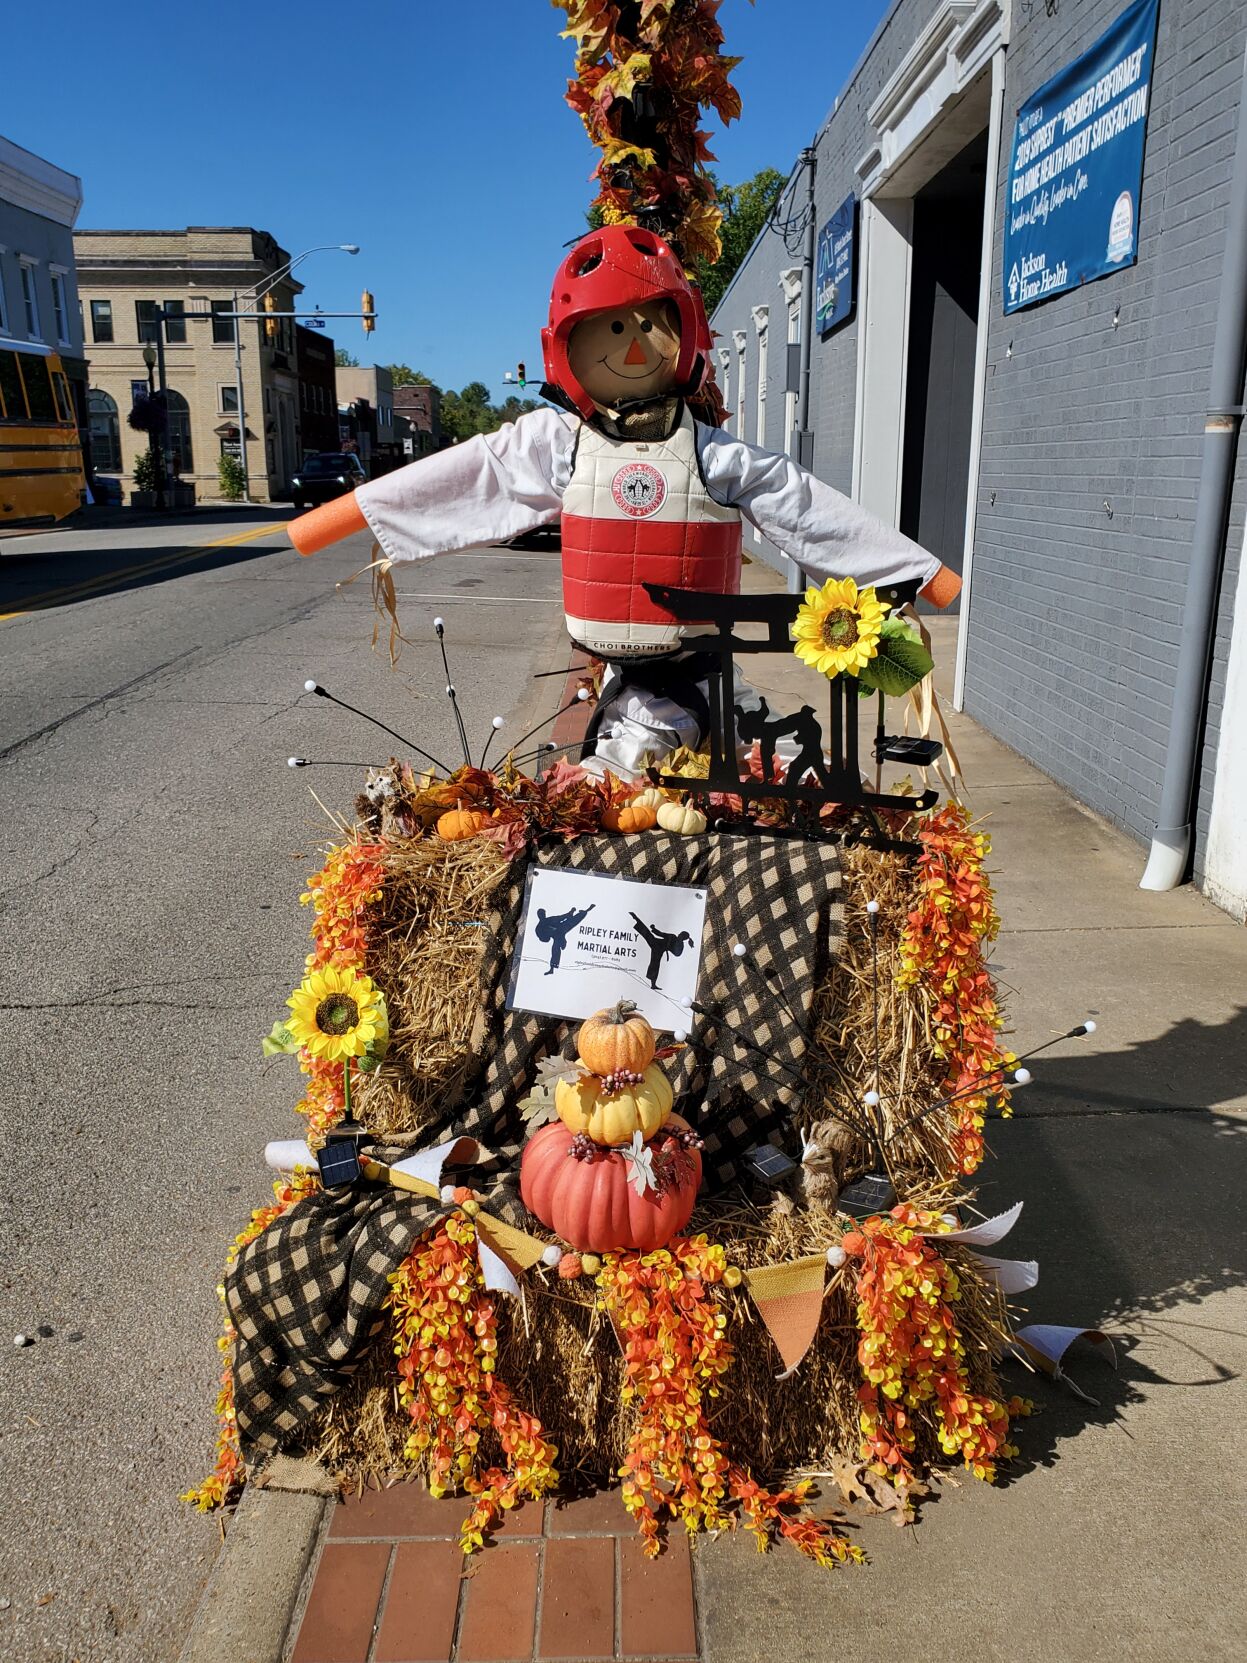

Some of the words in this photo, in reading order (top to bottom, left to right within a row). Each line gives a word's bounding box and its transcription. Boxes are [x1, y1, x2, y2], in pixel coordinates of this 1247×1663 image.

[1011, 174, 1025, 204] FOR
[1023, 162, 1041, 197] HOME
[1039, 145, 1064, 187] HEALTH
[1062, 125, 1092, 170] PATIENT
[1090, 83, 1148, 151] SATISFACTION
[1014, 138, 1031, 171] 2019
[1021, 252, 1046, 280] Jackson
[1019, 279, 1041, 302] Home
[1039, 260, 1068, 293] Health
[593, 642, 618, 650] CHOI
[579, 925, 607, 938] RIPLEY
[609, 929, 639, 942] FAMILY
[577, 940, 612, 955] MARTIAL
[614, 946, 637, 958] ARTS
